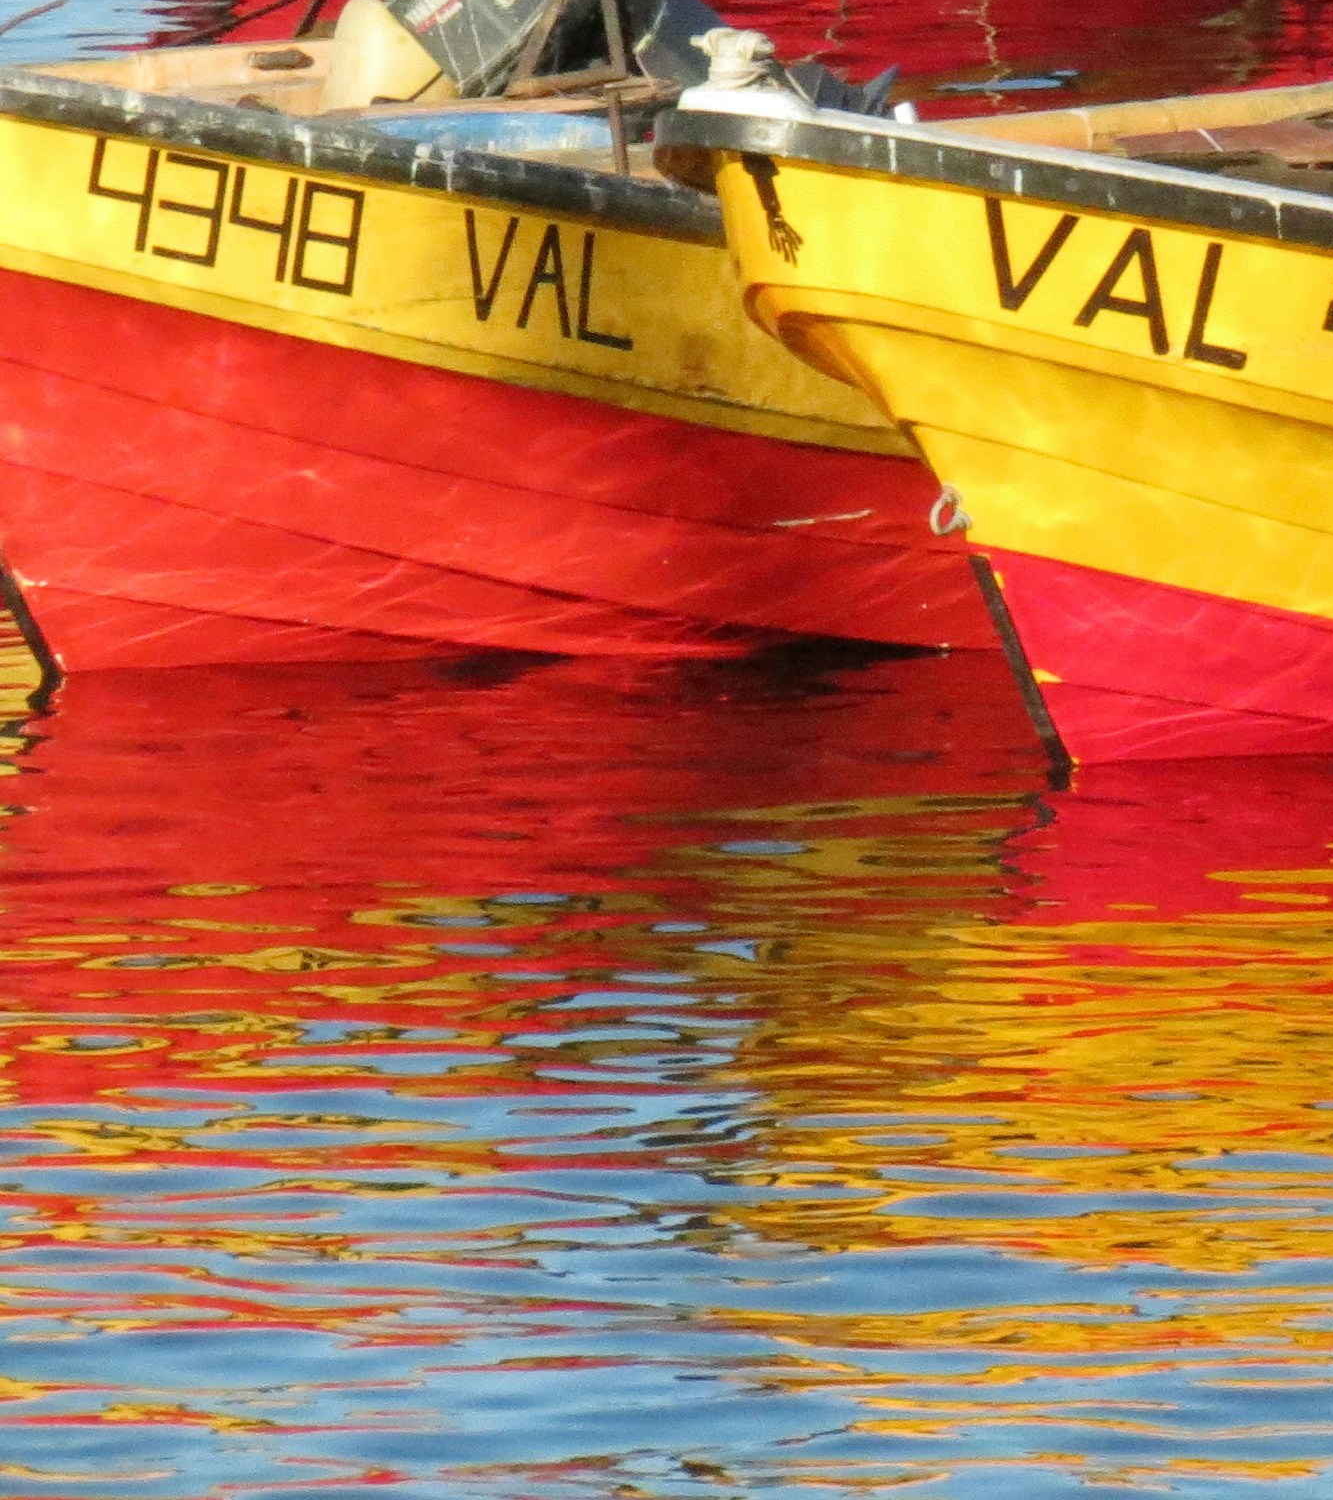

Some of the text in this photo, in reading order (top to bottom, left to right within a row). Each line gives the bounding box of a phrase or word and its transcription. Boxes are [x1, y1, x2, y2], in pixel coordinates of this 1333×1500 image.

[89, 138, 634, 352] 4348 VAL
[984, 196, 1248, 371] VAL
